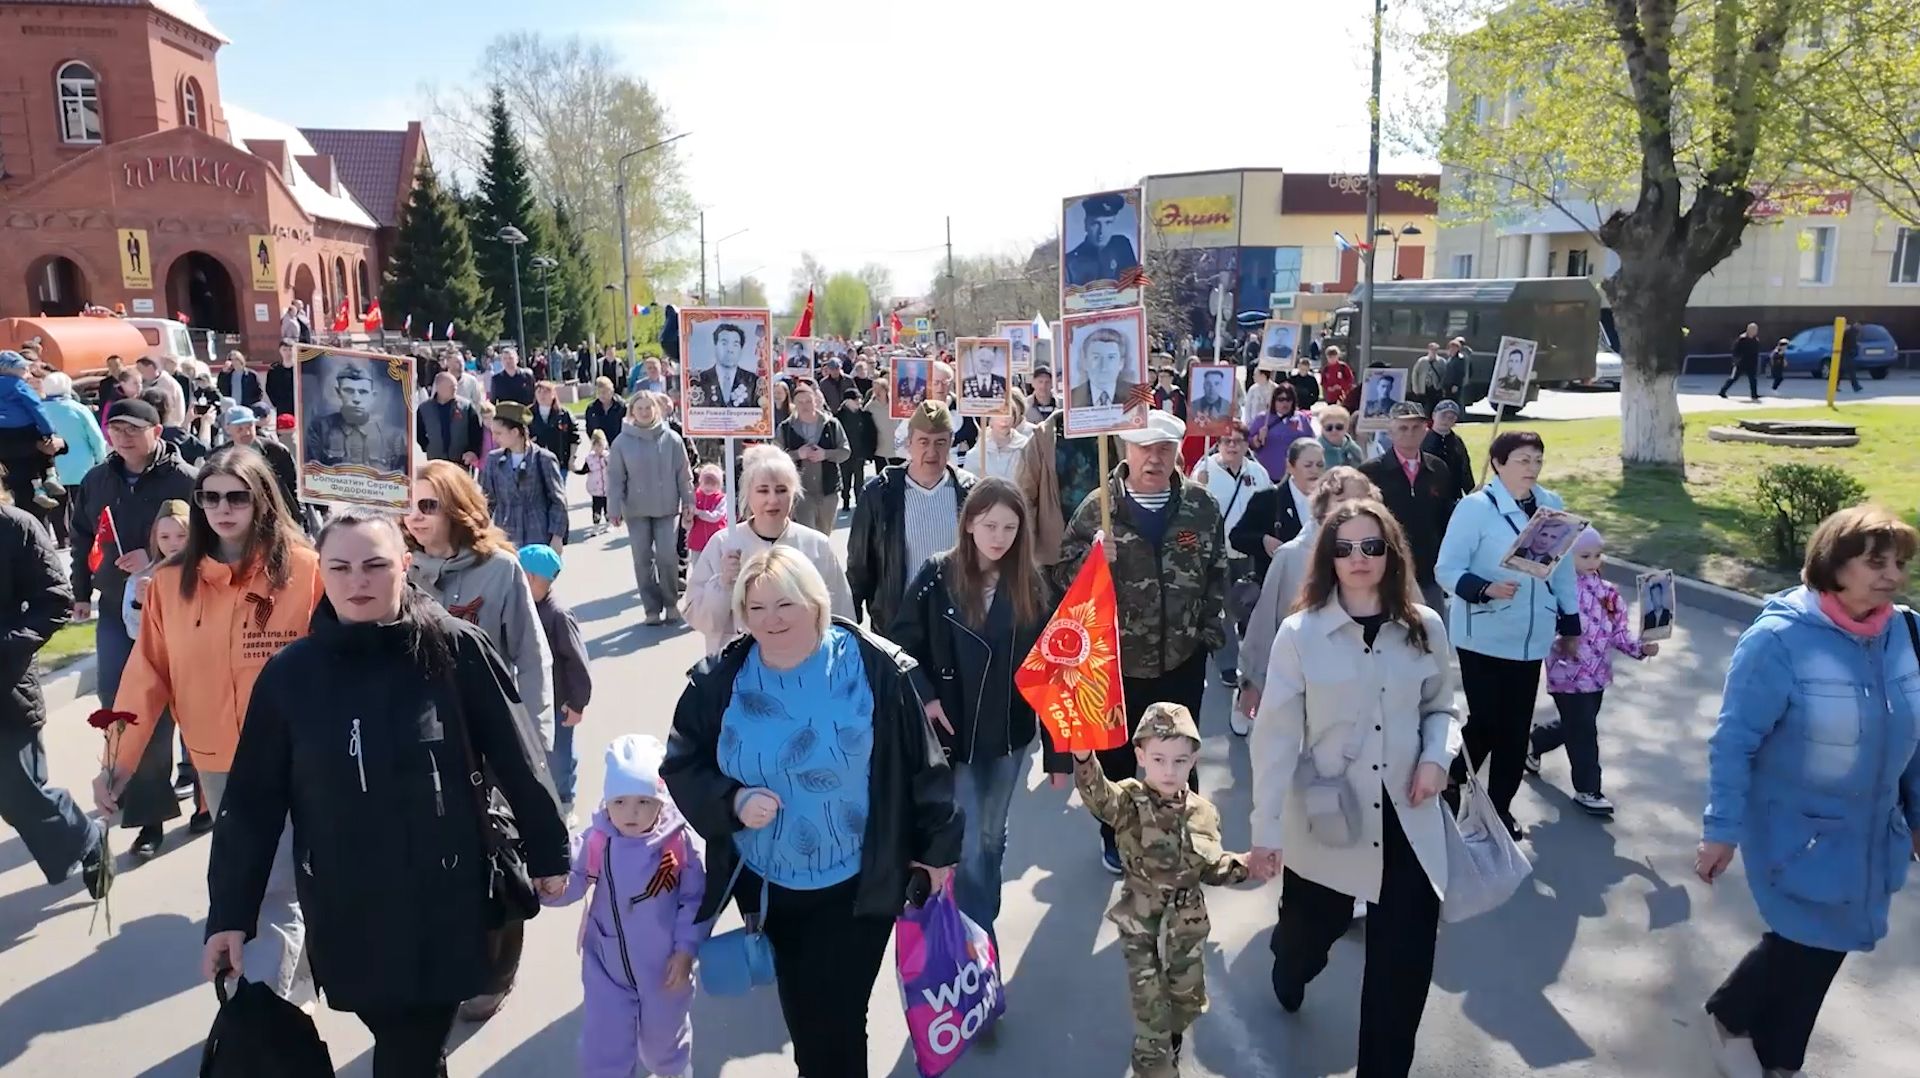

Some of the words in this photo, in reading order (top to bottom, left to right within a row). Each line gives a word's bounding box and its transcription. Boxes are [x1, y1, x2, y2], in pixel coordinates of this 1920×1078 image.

[312, 474, 364, 487] Соломатин
[367, 480, 400, 490] Сергей
[330, 484, 384, 496] Федорович
[243, 641, 272, 649] random
